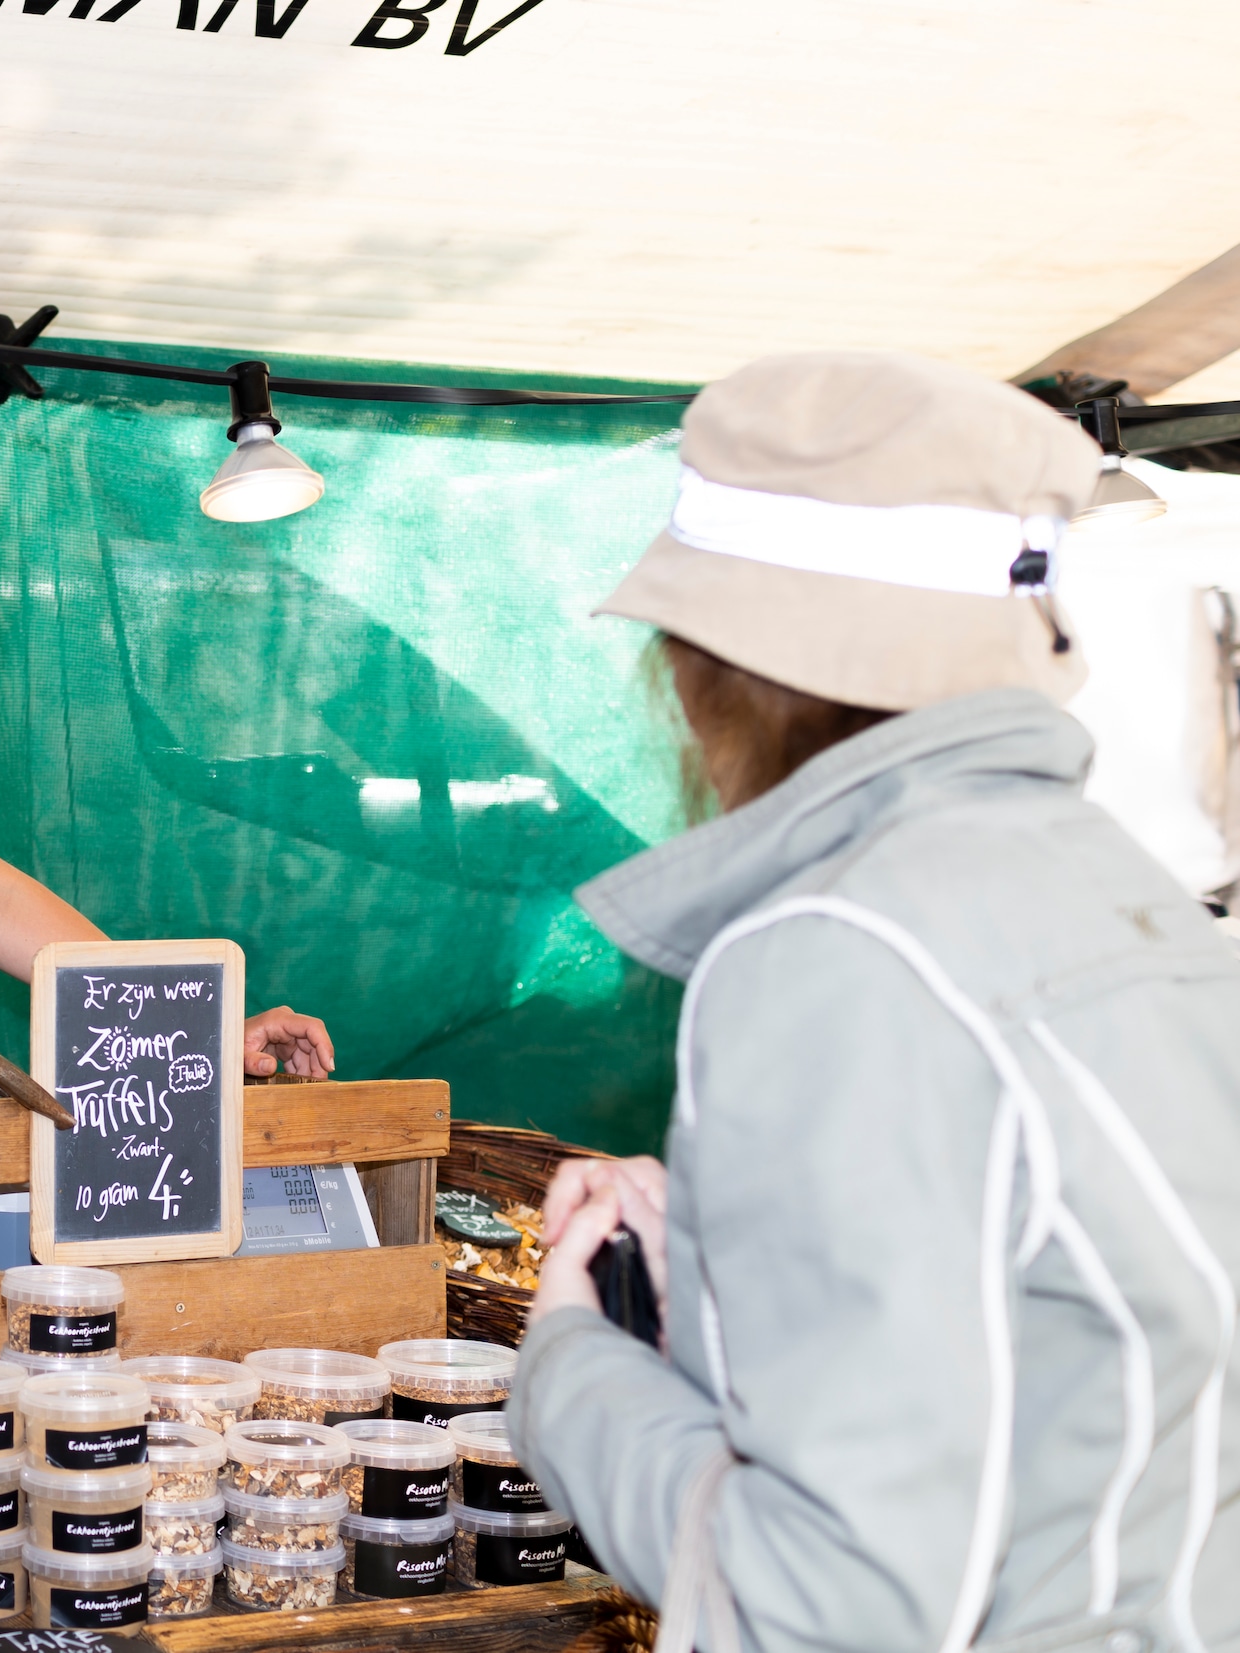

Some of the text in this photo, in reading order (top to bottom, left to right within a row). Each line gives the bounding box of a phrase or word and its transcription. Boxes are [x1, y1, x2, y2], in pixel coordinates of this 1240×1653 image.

[349, 0, 543, 56] BV
[83, 975, 116, 1010] Er
[77, 1026, 187, 1071] Zomer
[55, 1075, 174, 1137] Truffels
[76, 1185, 92, 1210] 10
[93, 1182, 139, 1222] gram
[406, 1483, 441, 1496] Risotto
[499, 1479, 542, 1492] Risotto
[396, 1559, 435, 1572] Risotto
[518, 1548, 556, 1561] Risotto
